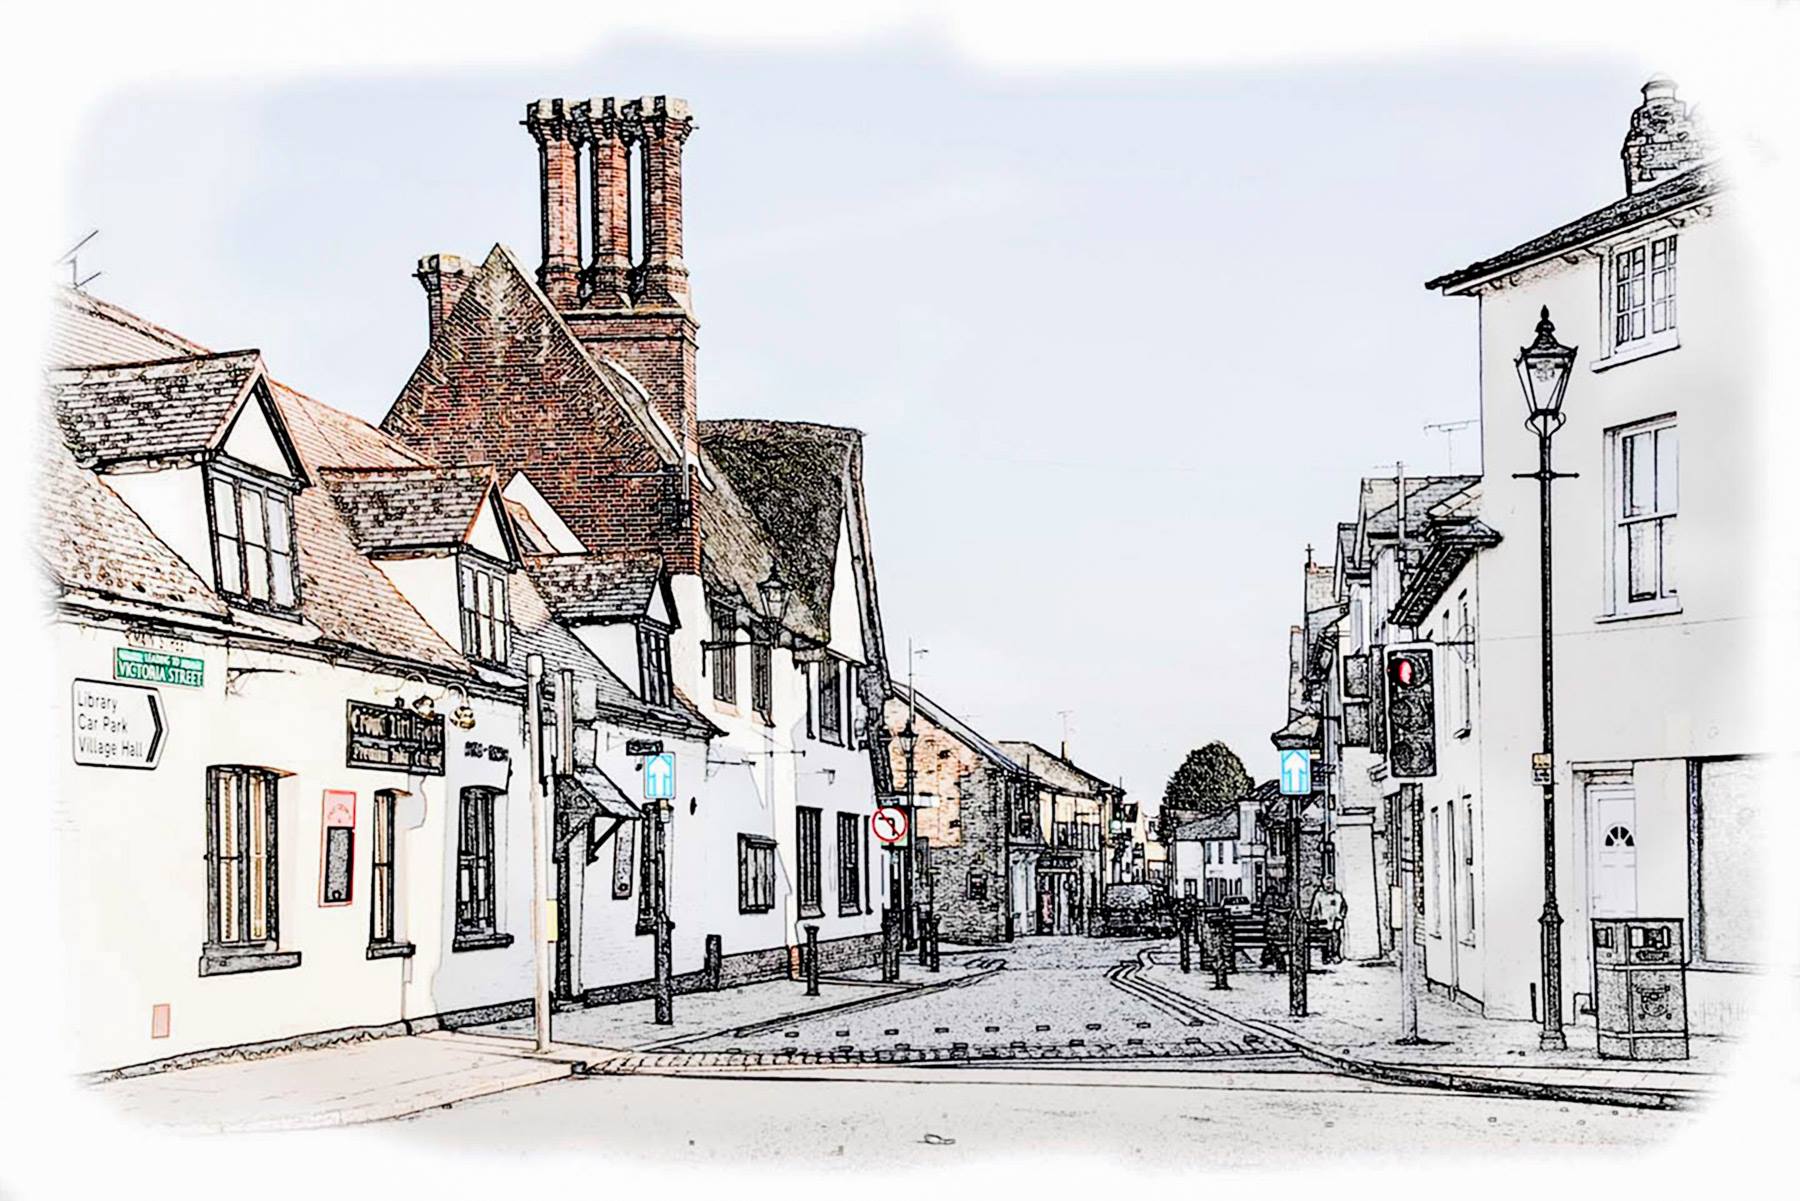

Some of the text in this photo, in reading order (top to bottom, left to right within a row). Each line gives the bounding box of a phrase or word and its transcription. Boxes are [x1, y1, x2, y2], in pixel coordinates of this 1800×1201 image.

[117, 660, 167, 683] VICTORIA
[168, 667, 202, 687] STREET
[78, 690, 118, 714] Library
[78, 713, 128, 733] Car Park
[78, 736, 143, 758] Village Hall
